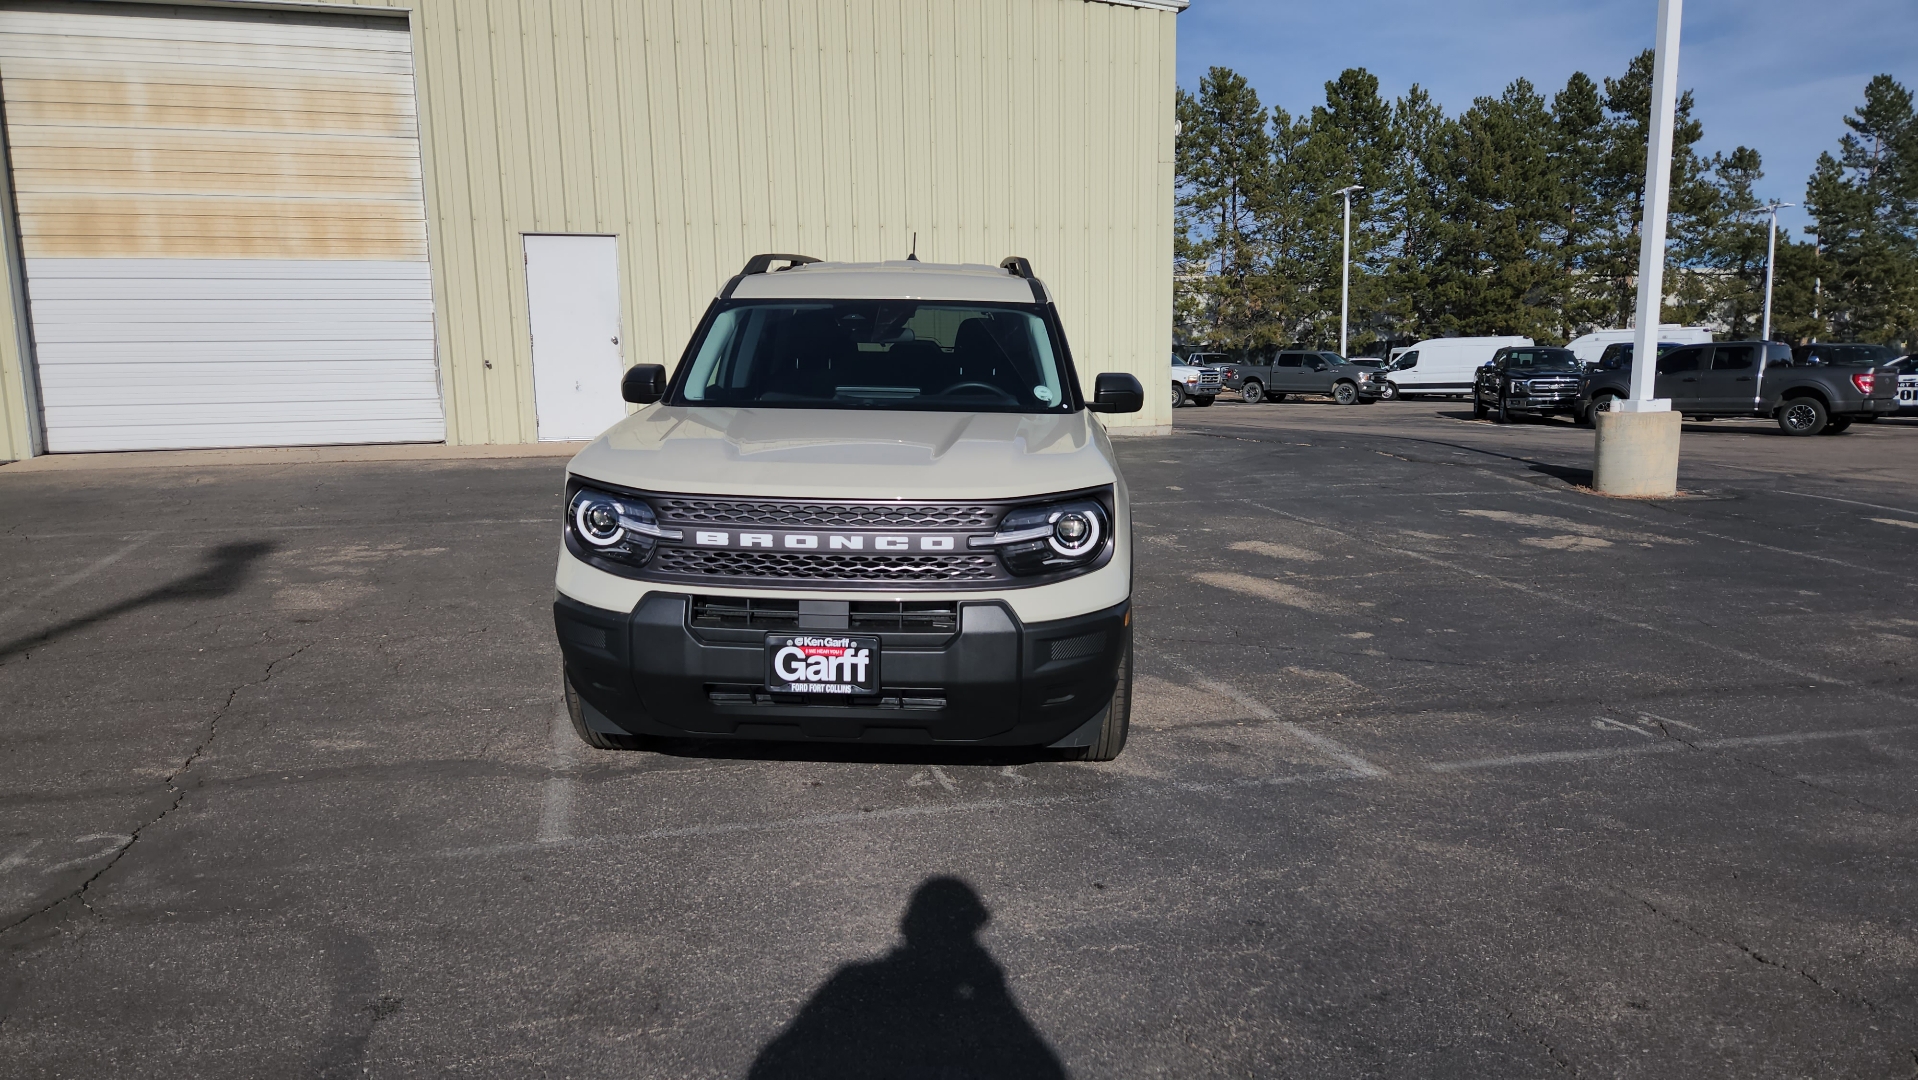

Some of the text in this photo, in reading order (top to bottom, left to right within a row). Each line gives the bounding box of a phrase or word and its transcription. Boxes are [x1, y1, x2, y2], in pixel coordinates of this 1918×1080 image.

[696, 531, 954, 550] BRONCO
[804, 637, 849, 647] Ken Garff
[774, 646, 869, 682] Garff
[792, 684, 851, 693] FORD FORT COLLINS
